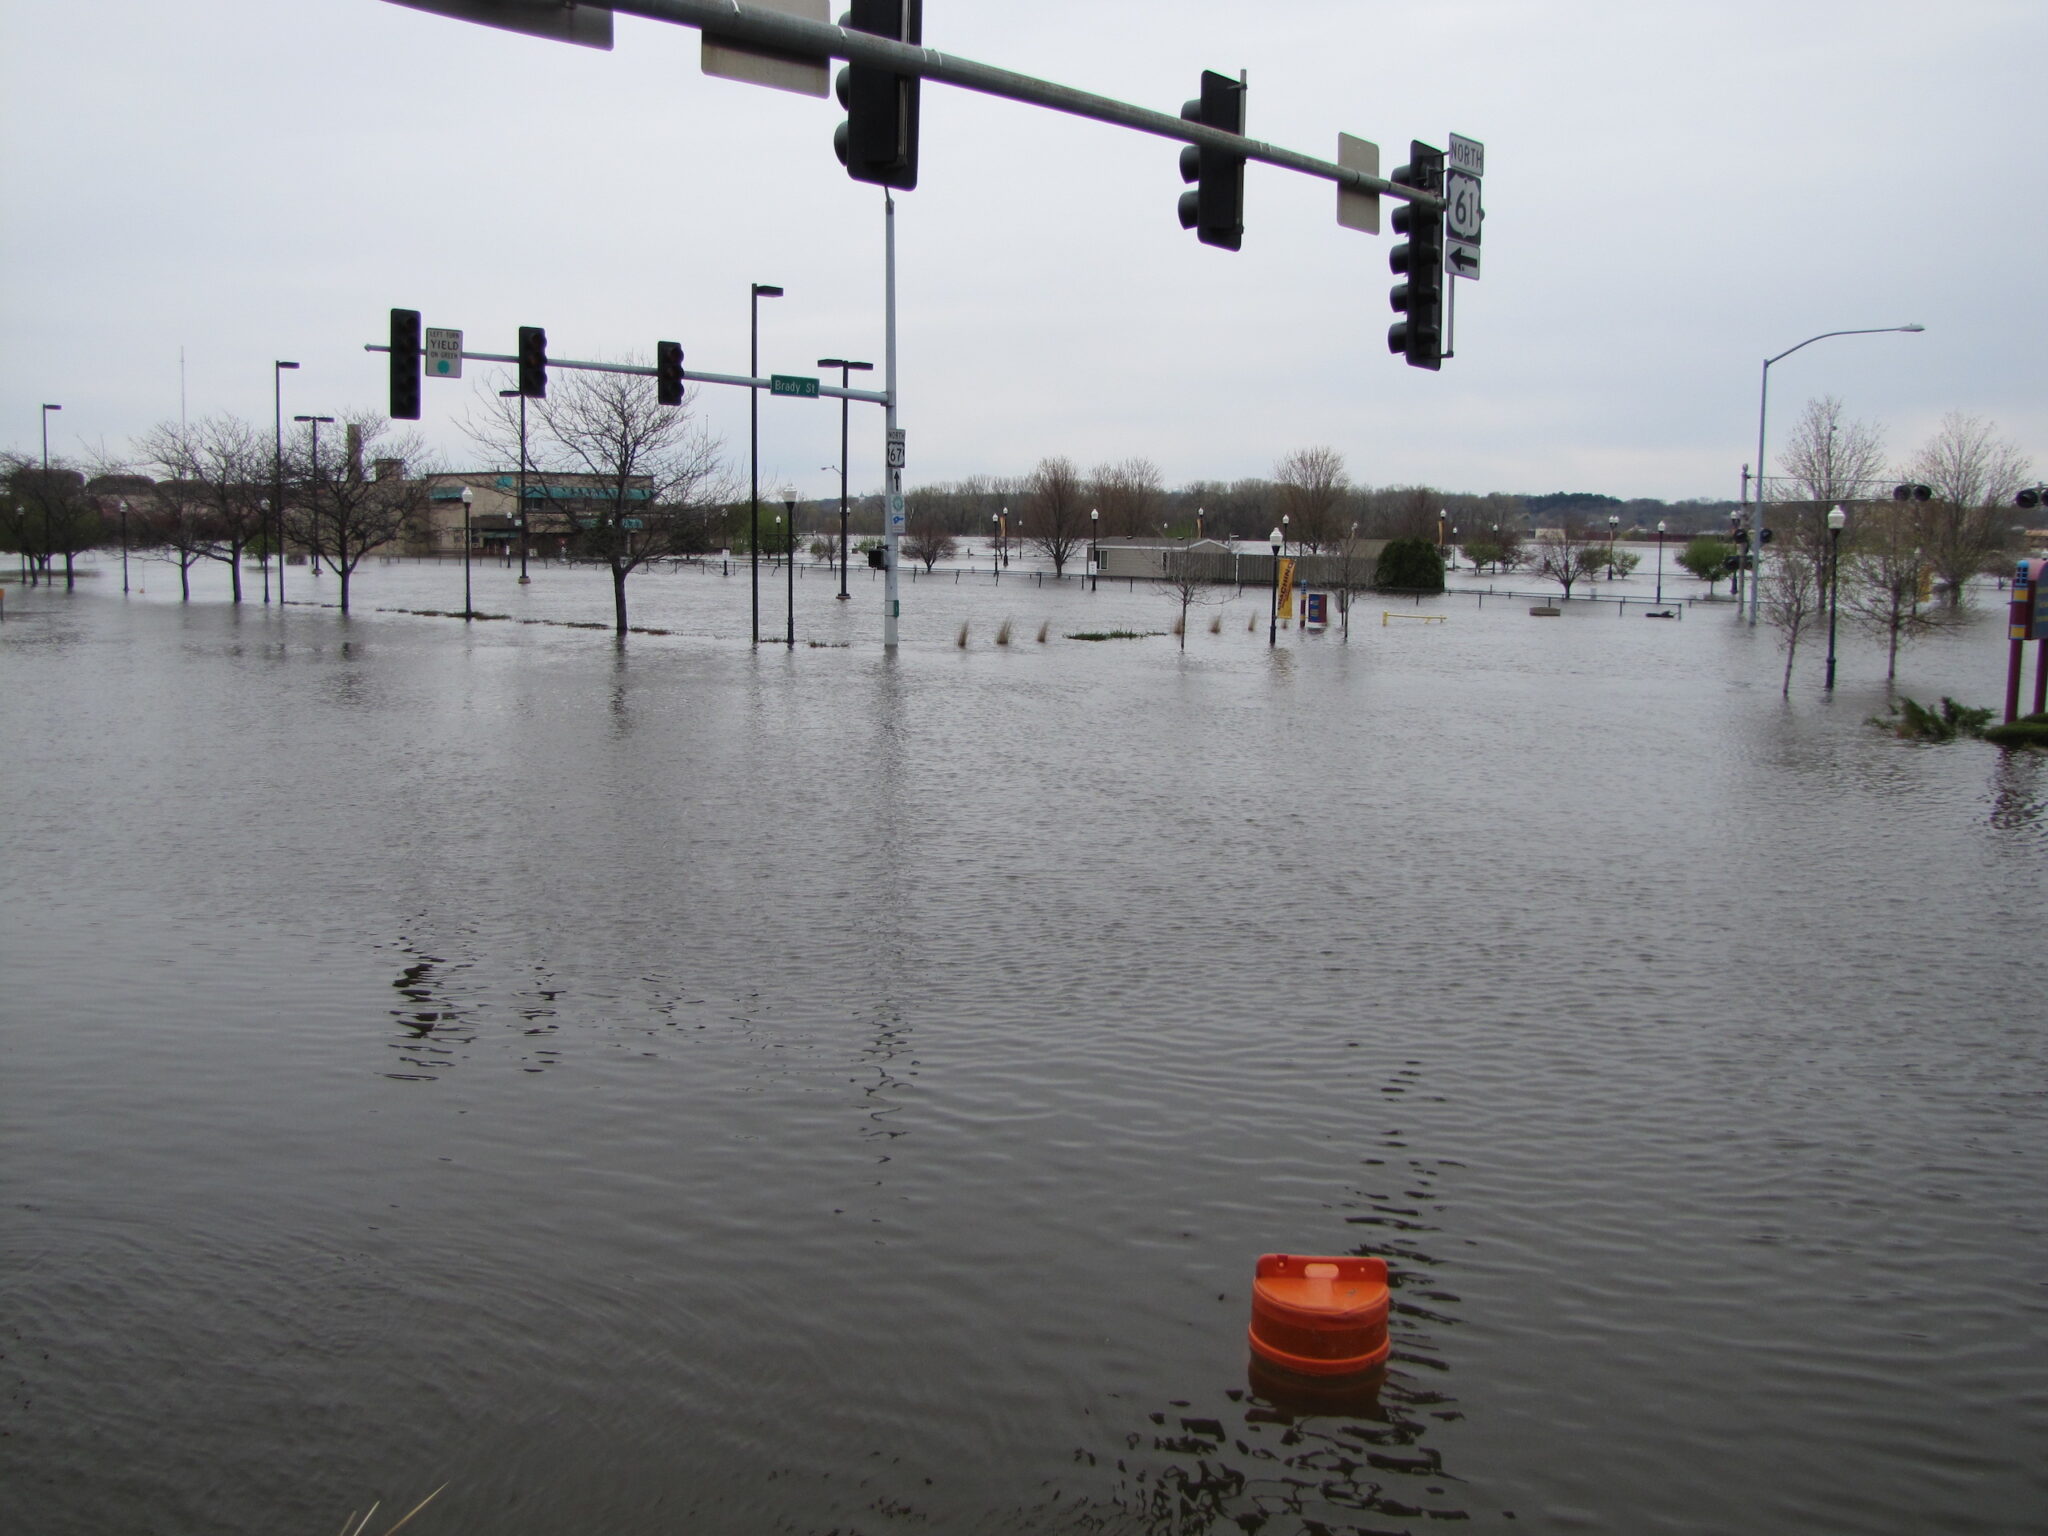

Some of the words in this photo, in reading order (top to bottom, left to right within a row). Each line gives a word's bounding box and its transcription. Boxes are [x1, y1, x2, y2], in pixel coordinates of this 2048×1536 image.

[1451, 142, 1482, 168] NORTH
[1455, 190, 1473, 228] 61
[430, 340, 459, 351] YIELD
[441, 352, 458, 360] GREEN
[775, 380, 801, 395] Brady
[806, 383, 816, 393] St
[888, 431, 904, 439] NORTH
[890, 448, 902, 462] 67
